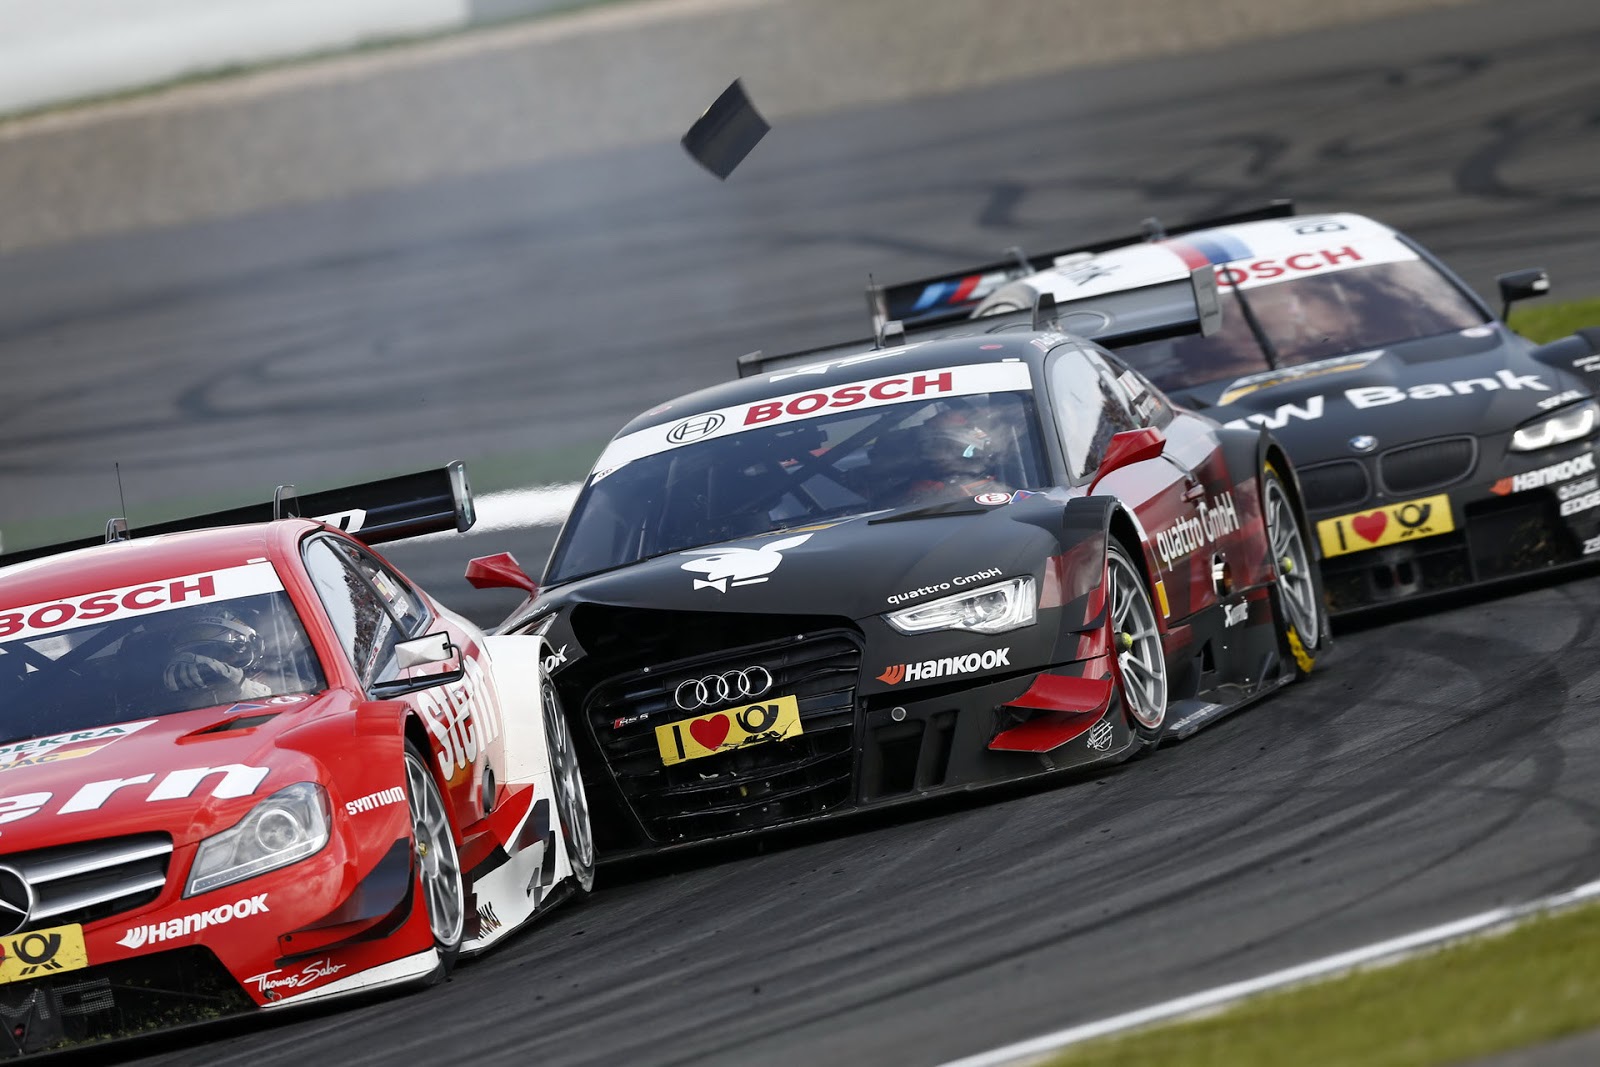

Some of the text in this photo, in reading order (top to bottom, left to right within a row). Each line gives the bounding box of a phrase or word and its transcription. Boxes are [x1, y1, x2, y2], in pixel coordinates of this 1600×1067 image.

[1215, 246, 1364, 287] OSCH
[743, 371, 953, 426] BOSCH
[1344, 369, 1551, 410] Bank
[1156, 515, 1205, 572] quattro
[0, 575, 216, 638] BOSCH
[887, 567, 1003, 605] quattro GmbH
[243, 957, 347, 992] Thomas Sabo
